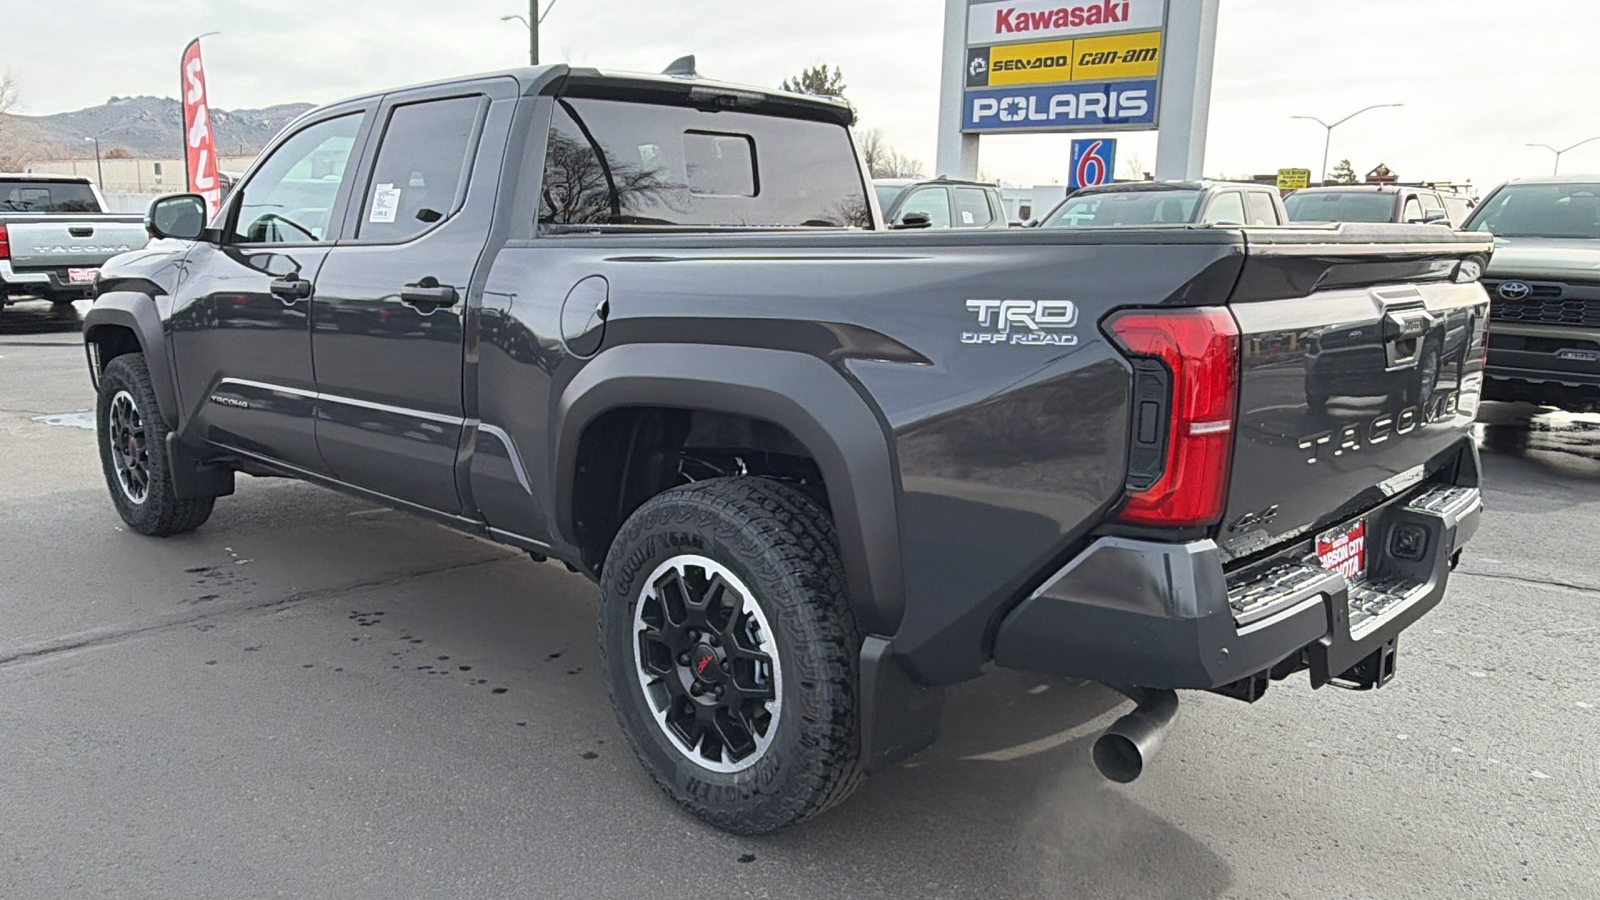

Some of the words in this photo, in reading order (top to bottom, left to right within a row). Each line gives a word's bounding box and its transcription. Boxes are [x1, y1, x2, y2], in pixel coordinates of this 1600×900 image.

[996, 0, 1130, 34] Kawasaki
[1078, 47, 1158, 66] can-am
[972, 90, 1148, 123] POLARIS
[1076, 140, 1106, 188] 6
[34, 245, 131, 253] TACOMA
[966, 299, 1079, 334] TRD
[960, 332, 1008, 344] OFF
[1009, 333, 1079, 346] ROAD
[210, 395, 249, 409] TACOMA
[1298, 390, 1459, 464] TACOMA
[1348, 536, 1364, 557] CITY
